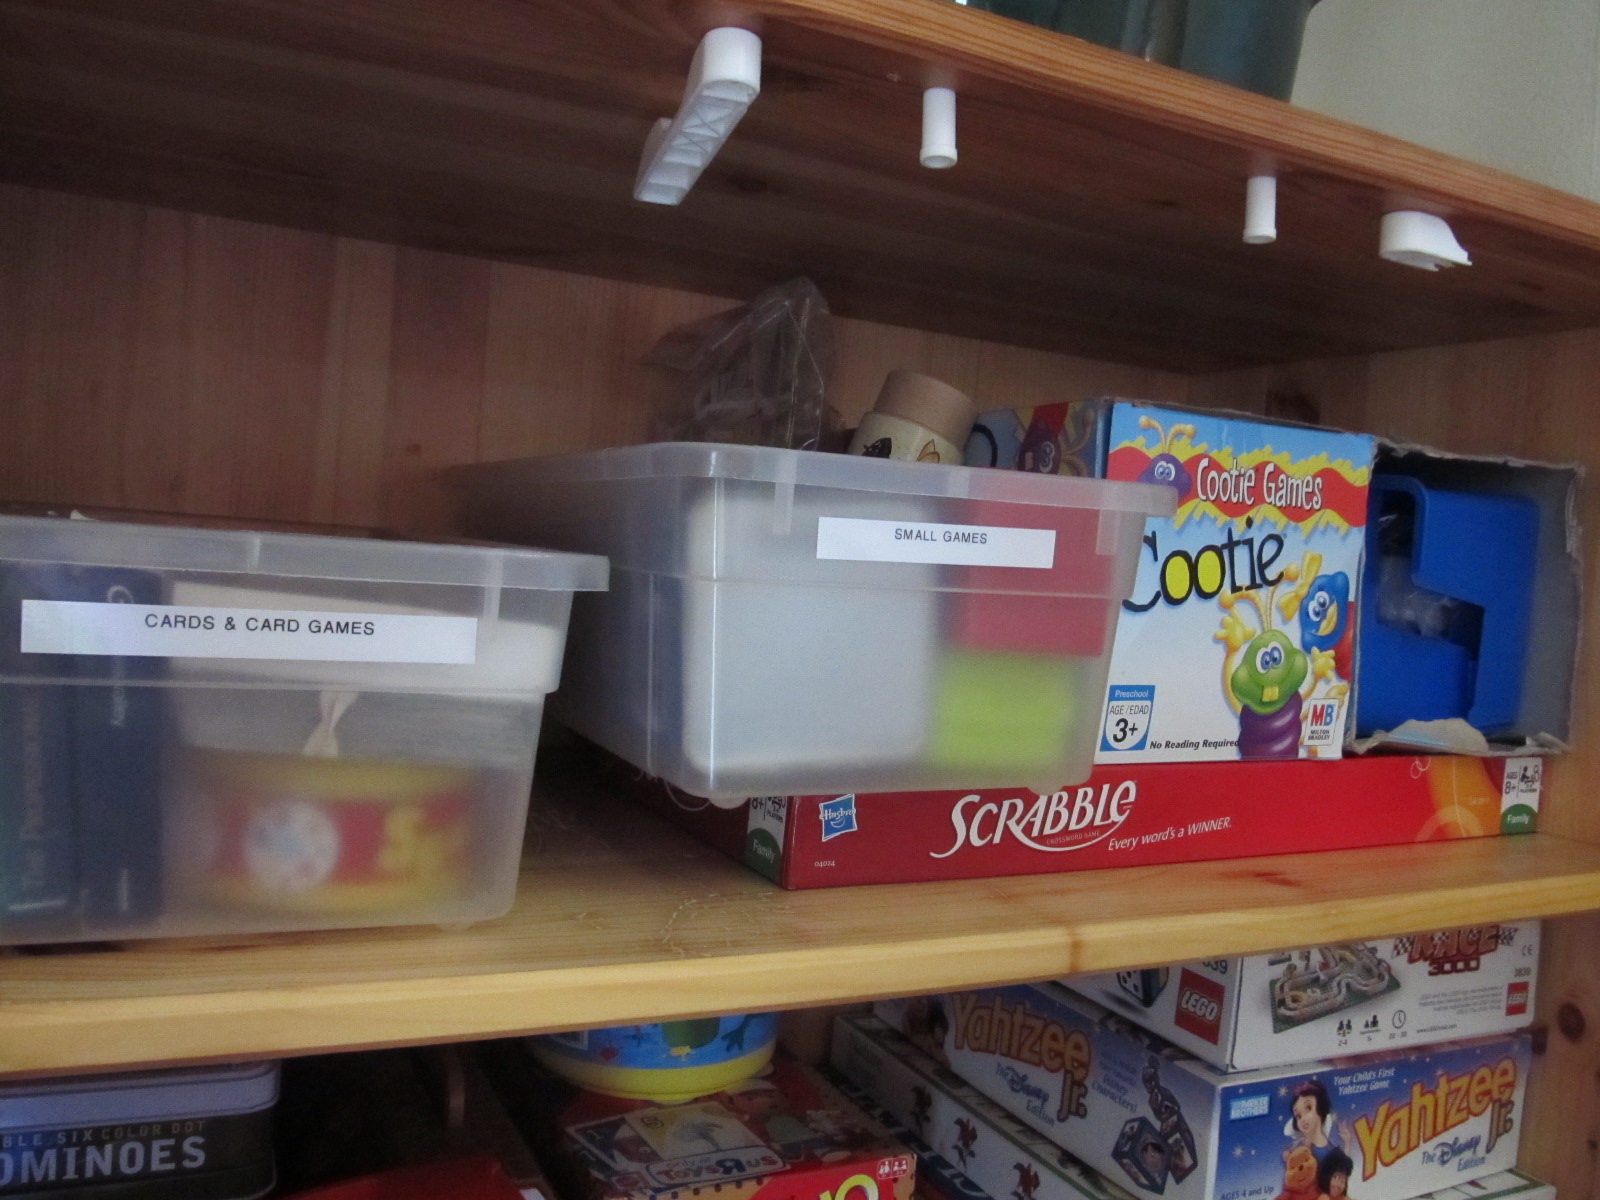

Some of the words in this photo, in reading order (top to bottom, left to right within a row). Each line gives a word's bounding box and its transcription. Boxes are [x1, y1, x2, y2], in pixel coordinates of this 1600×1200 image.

[1197, 457, 1255, 505] Cootie
[1263, 461, 1323, 510] Games
[894, 528, 937, 542] SMALL
[943, 531, 988, 544] GAMES
[145, 613, 215, 630] CARDS
[225, 617, 236, 631] &
[245, 617, 300, 633] CARD
[308, 620, 375, 636] GAMES
[1114, 689, 1149, 698] Preschool
[1109, 704, 1125, 715] AGE
[1310, 704, 1335, 726] MB
[1112, 718, 1138, 743] 3+
[1150, 740, 1161, 749] No
[1164, 740, 1200, 750] Reading
[1202, 739, 1240, 749] Required
[1504, 781, 1516, 794] 8+
[824, 808, 856, 820] Hasbro
[930, 780, 1137, 858] SCRABBLE
[1507, 814, 1530, 825] Family
[1108, 835, 1139, 851] Every
[1141, 827, 1175, 844] word's
[753, 839, 776, 863] Family
[1180, 989, 1219, 1022] LEGO
[953, 994, 1091, 1082] Yahtzee
[1333, 1075, 1351, 1086] Your
[1352, 1070, 1377, 1083] Child's
[1378, 1067, 1396, 1077] First
[1057, 1070, 1089, 1122] Jr.
[1338, 1083, 1367, 1096] Yahtzee
[1370, 1080, 1390, 1091] Game
[1354, 1057, 1517, 1181] Yahtzee
[57, 1129, 94, 1144] SIX
[101, 1124, 162, 1140] COLOR
[171, 1121, 206, 1134] DOT
[1248, 1187, 1262, 1196] and
[1264, 1186, 1275, 1194] Up
